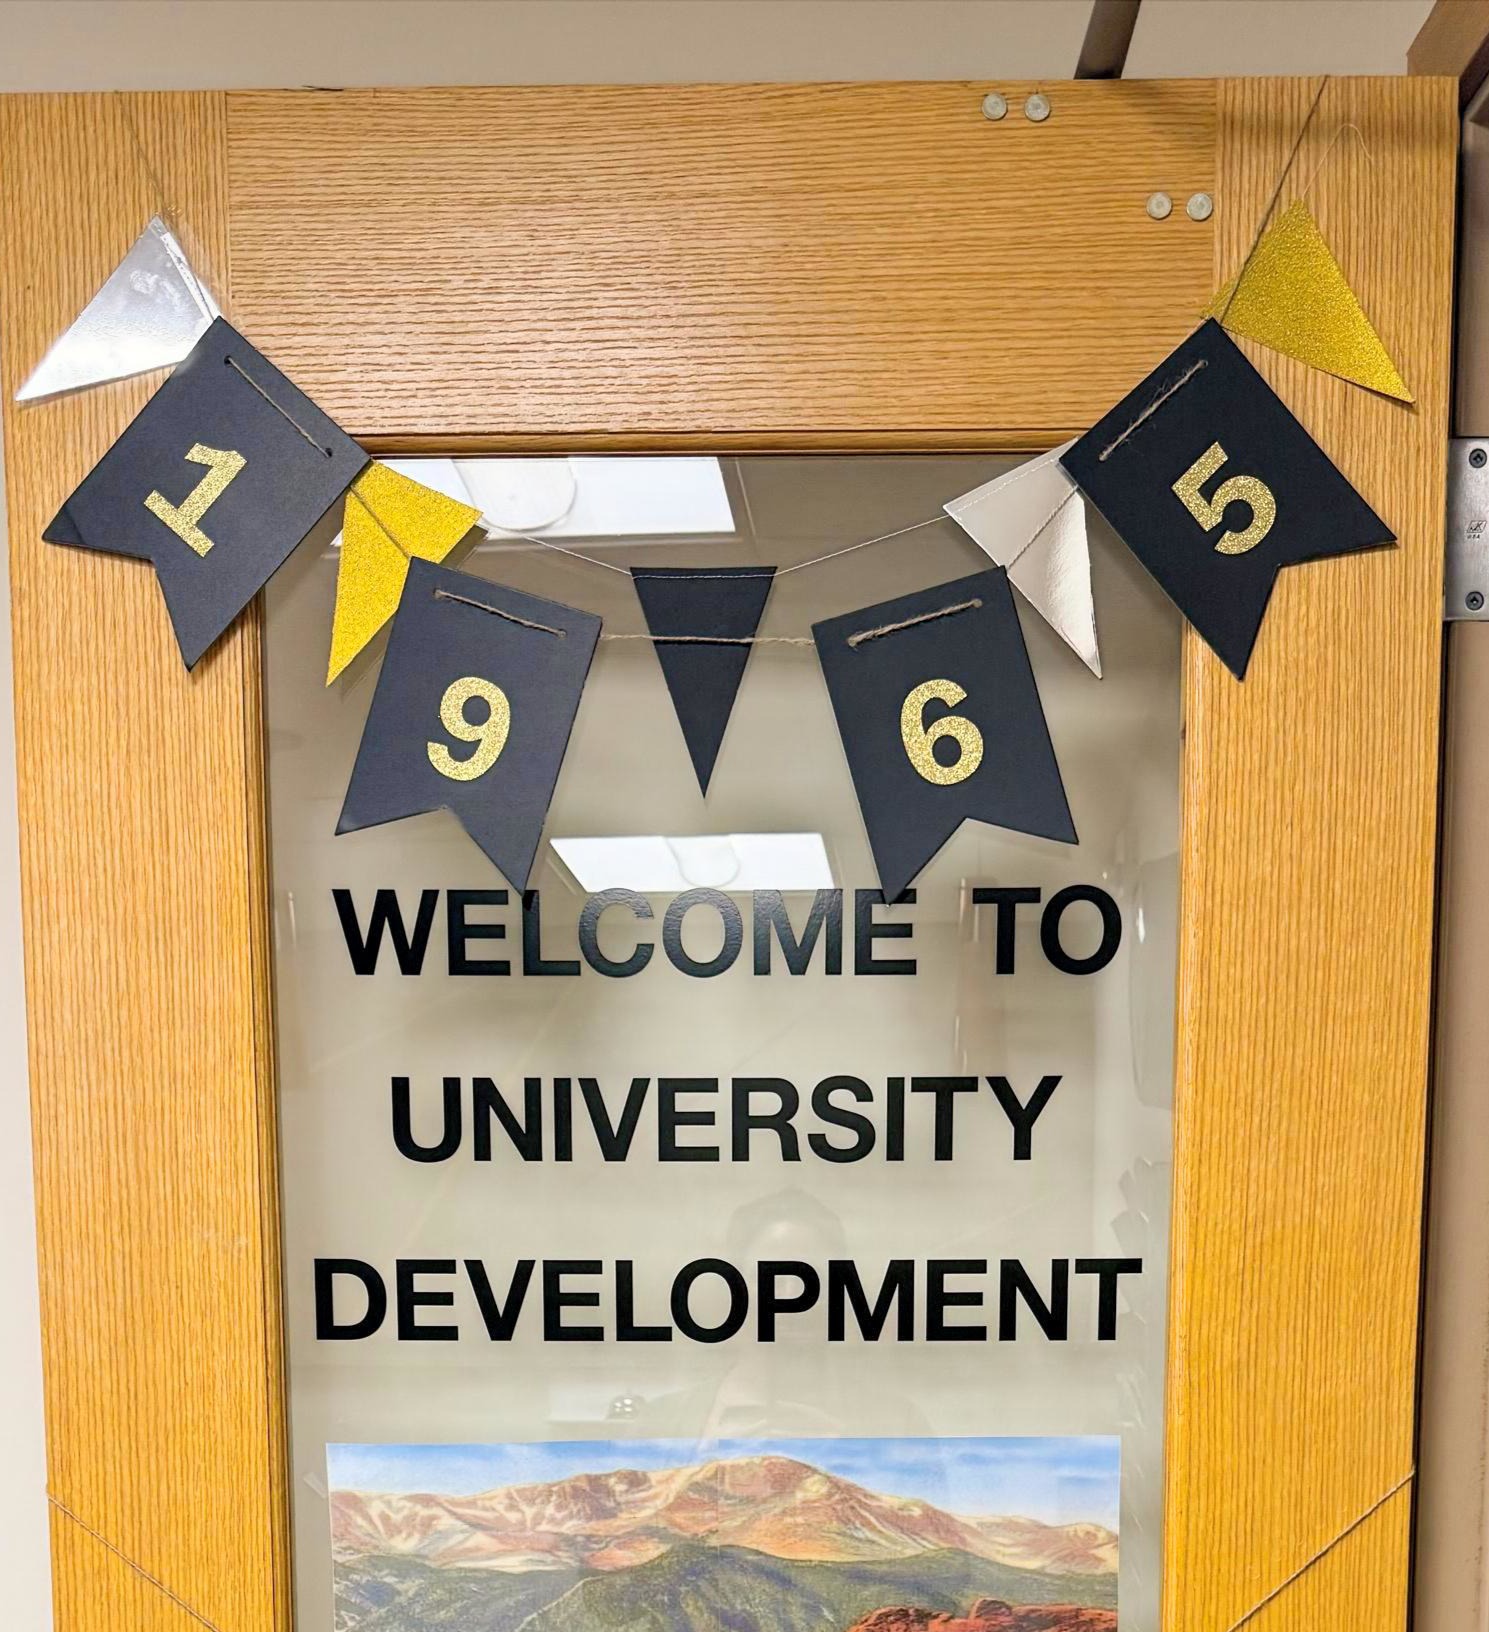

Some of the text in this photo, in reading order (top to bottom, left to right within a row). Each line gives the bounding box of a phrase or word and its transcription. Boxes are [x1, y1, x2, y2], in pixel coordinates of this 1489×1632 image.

[332, 884, 1122, 978] WELCOME TO
[390, 1074, 1063, 1164] UNIVERSITY
[313, 1257, 1144, 1344] DEVELOPMENT
